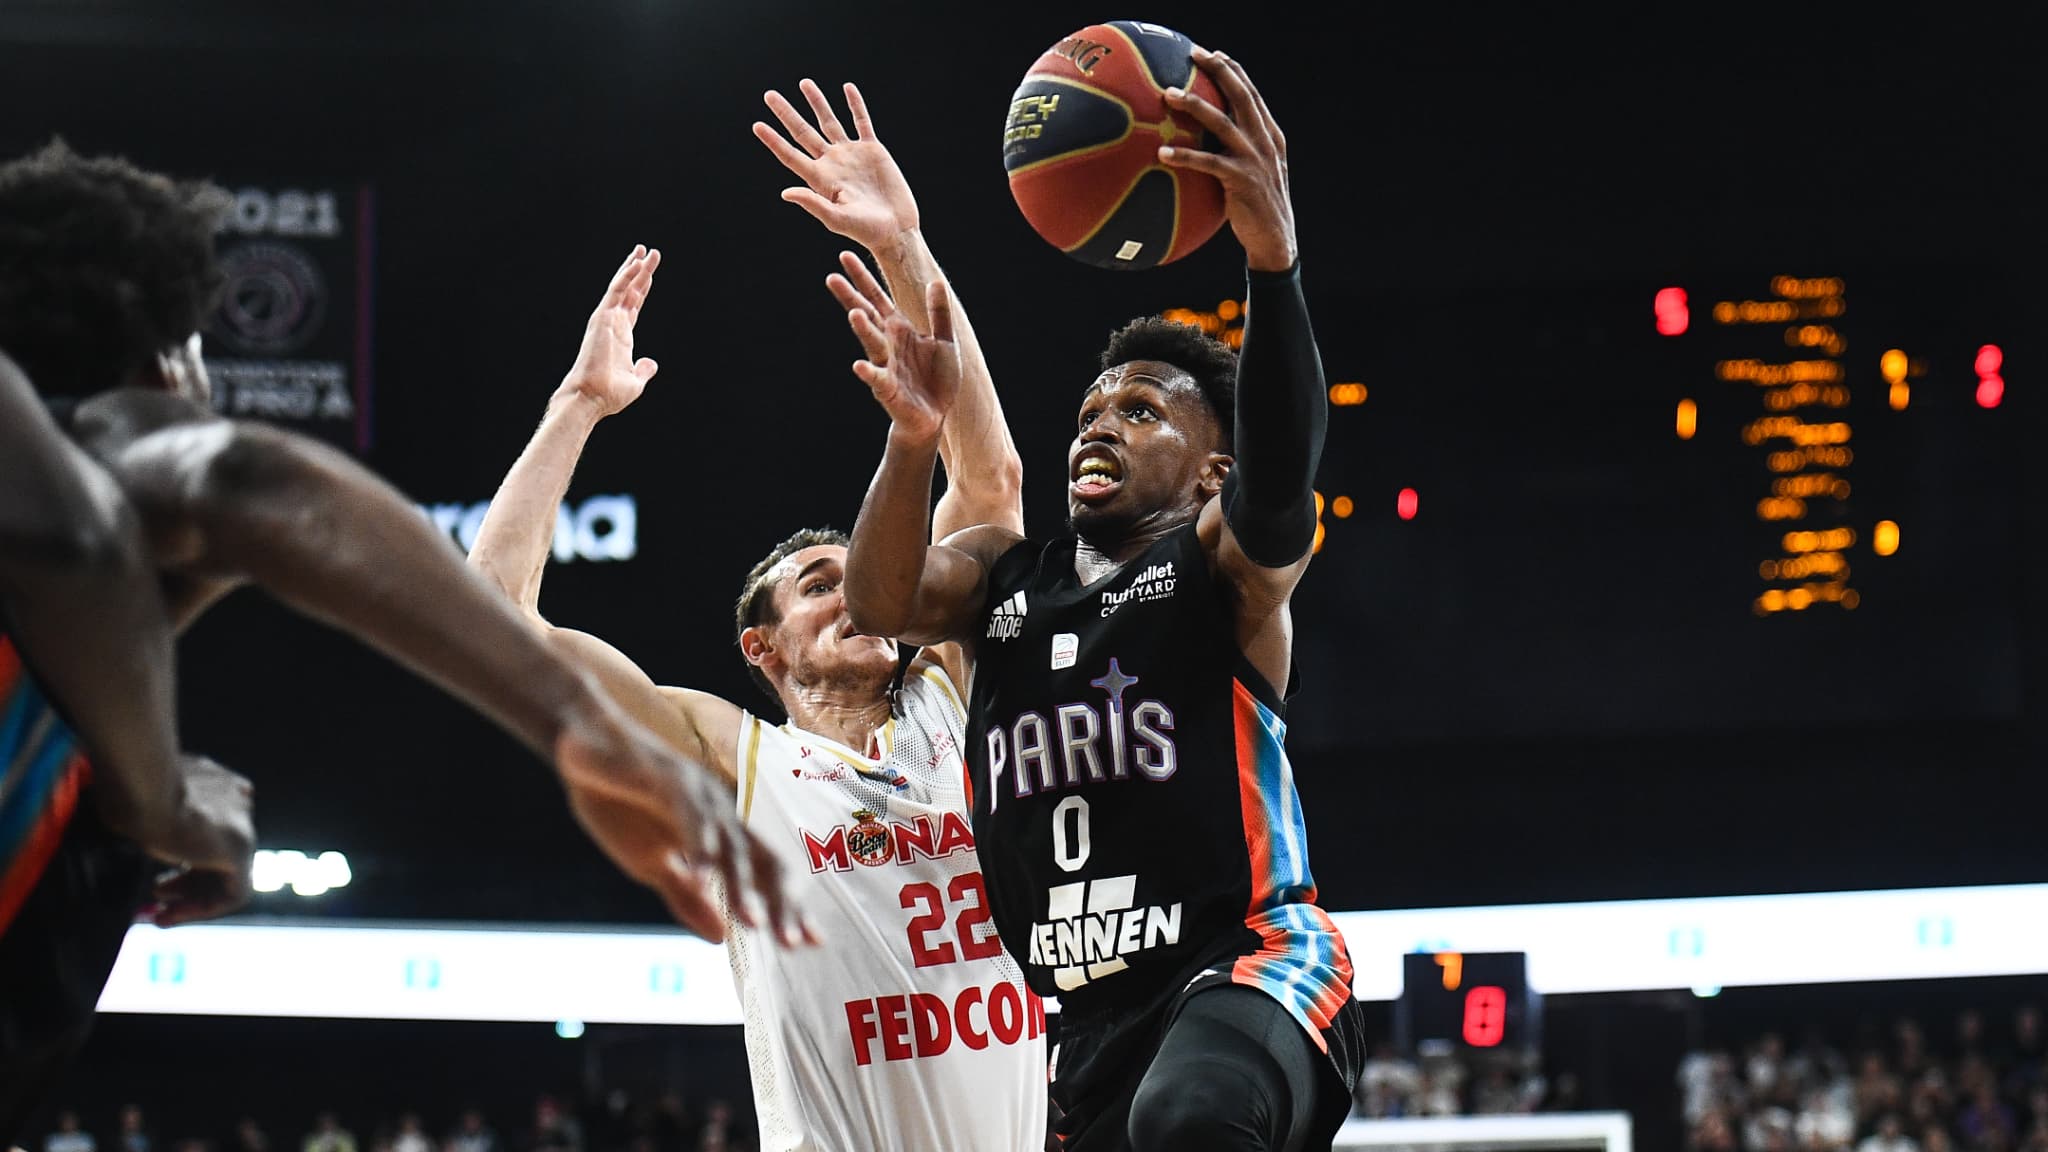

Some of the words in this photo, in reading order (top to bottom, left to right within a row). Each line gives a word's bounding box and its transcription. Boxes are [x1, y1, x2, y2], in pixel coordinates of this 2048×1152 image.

[217, 186, 340, 236] 021
[986, 697, 1177, 815] PARIS
[1053, 795, 1091, 873] 0
[899, 871, 1003, 968] 22
